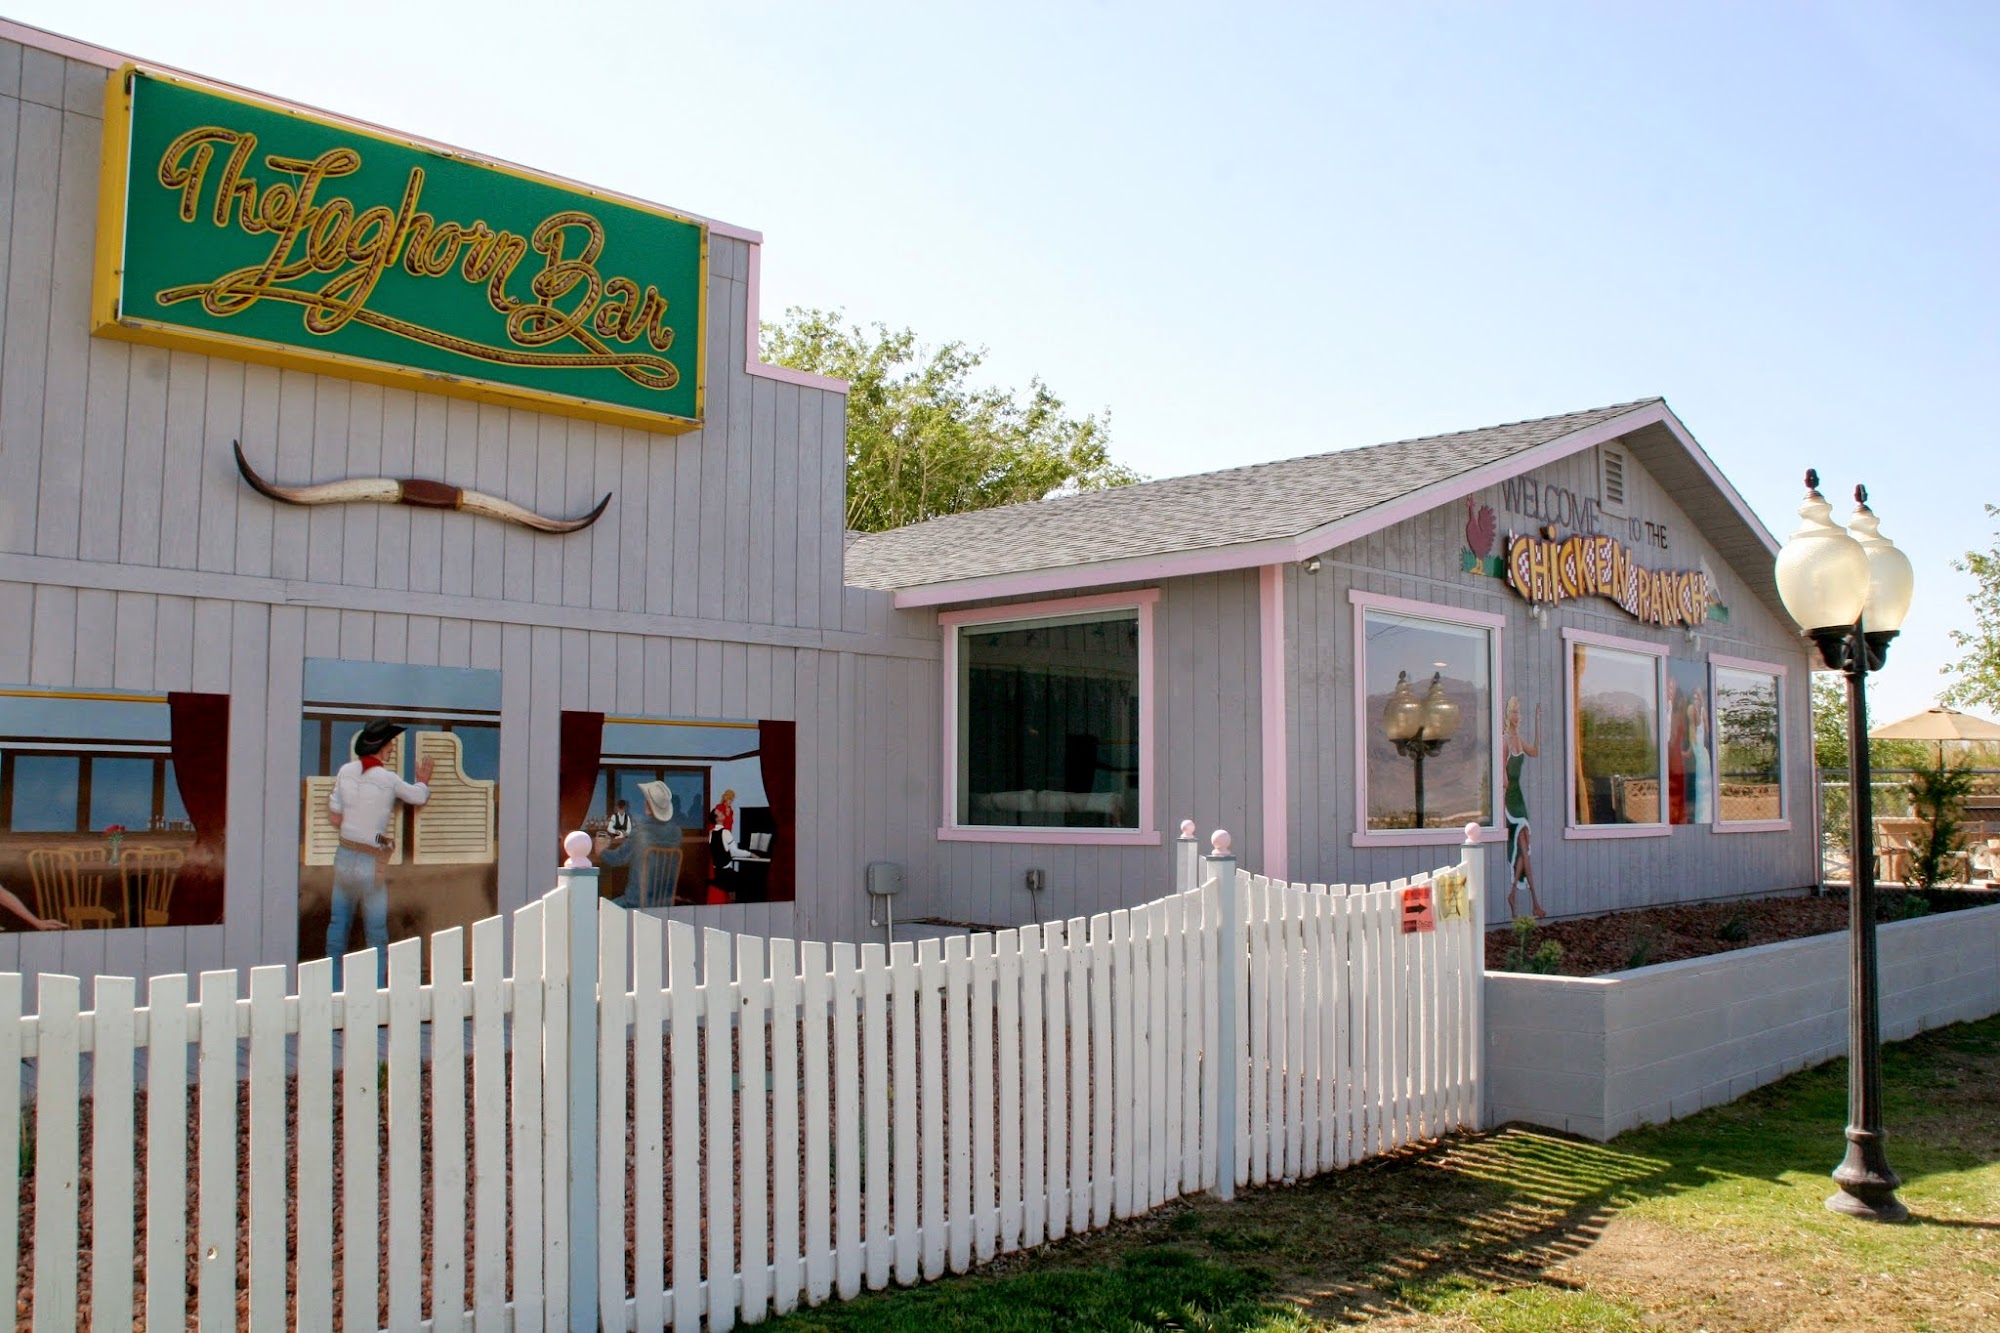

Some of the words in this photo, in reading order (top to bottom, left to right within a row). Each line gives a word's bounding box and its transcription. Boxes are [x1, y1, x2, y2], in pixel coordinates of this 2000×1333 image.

[157, 125, 306, 235] The
[202, 147, 528, 336] Leghorn
[507, 211, 677, 353] Bar
[1501, 474, 1600, 535] WELCOME
[1627, 516, 1642, 542] TO
[1645, 521, 1668, 549] THE
[1637, 565, 1705, 626] RANCH
